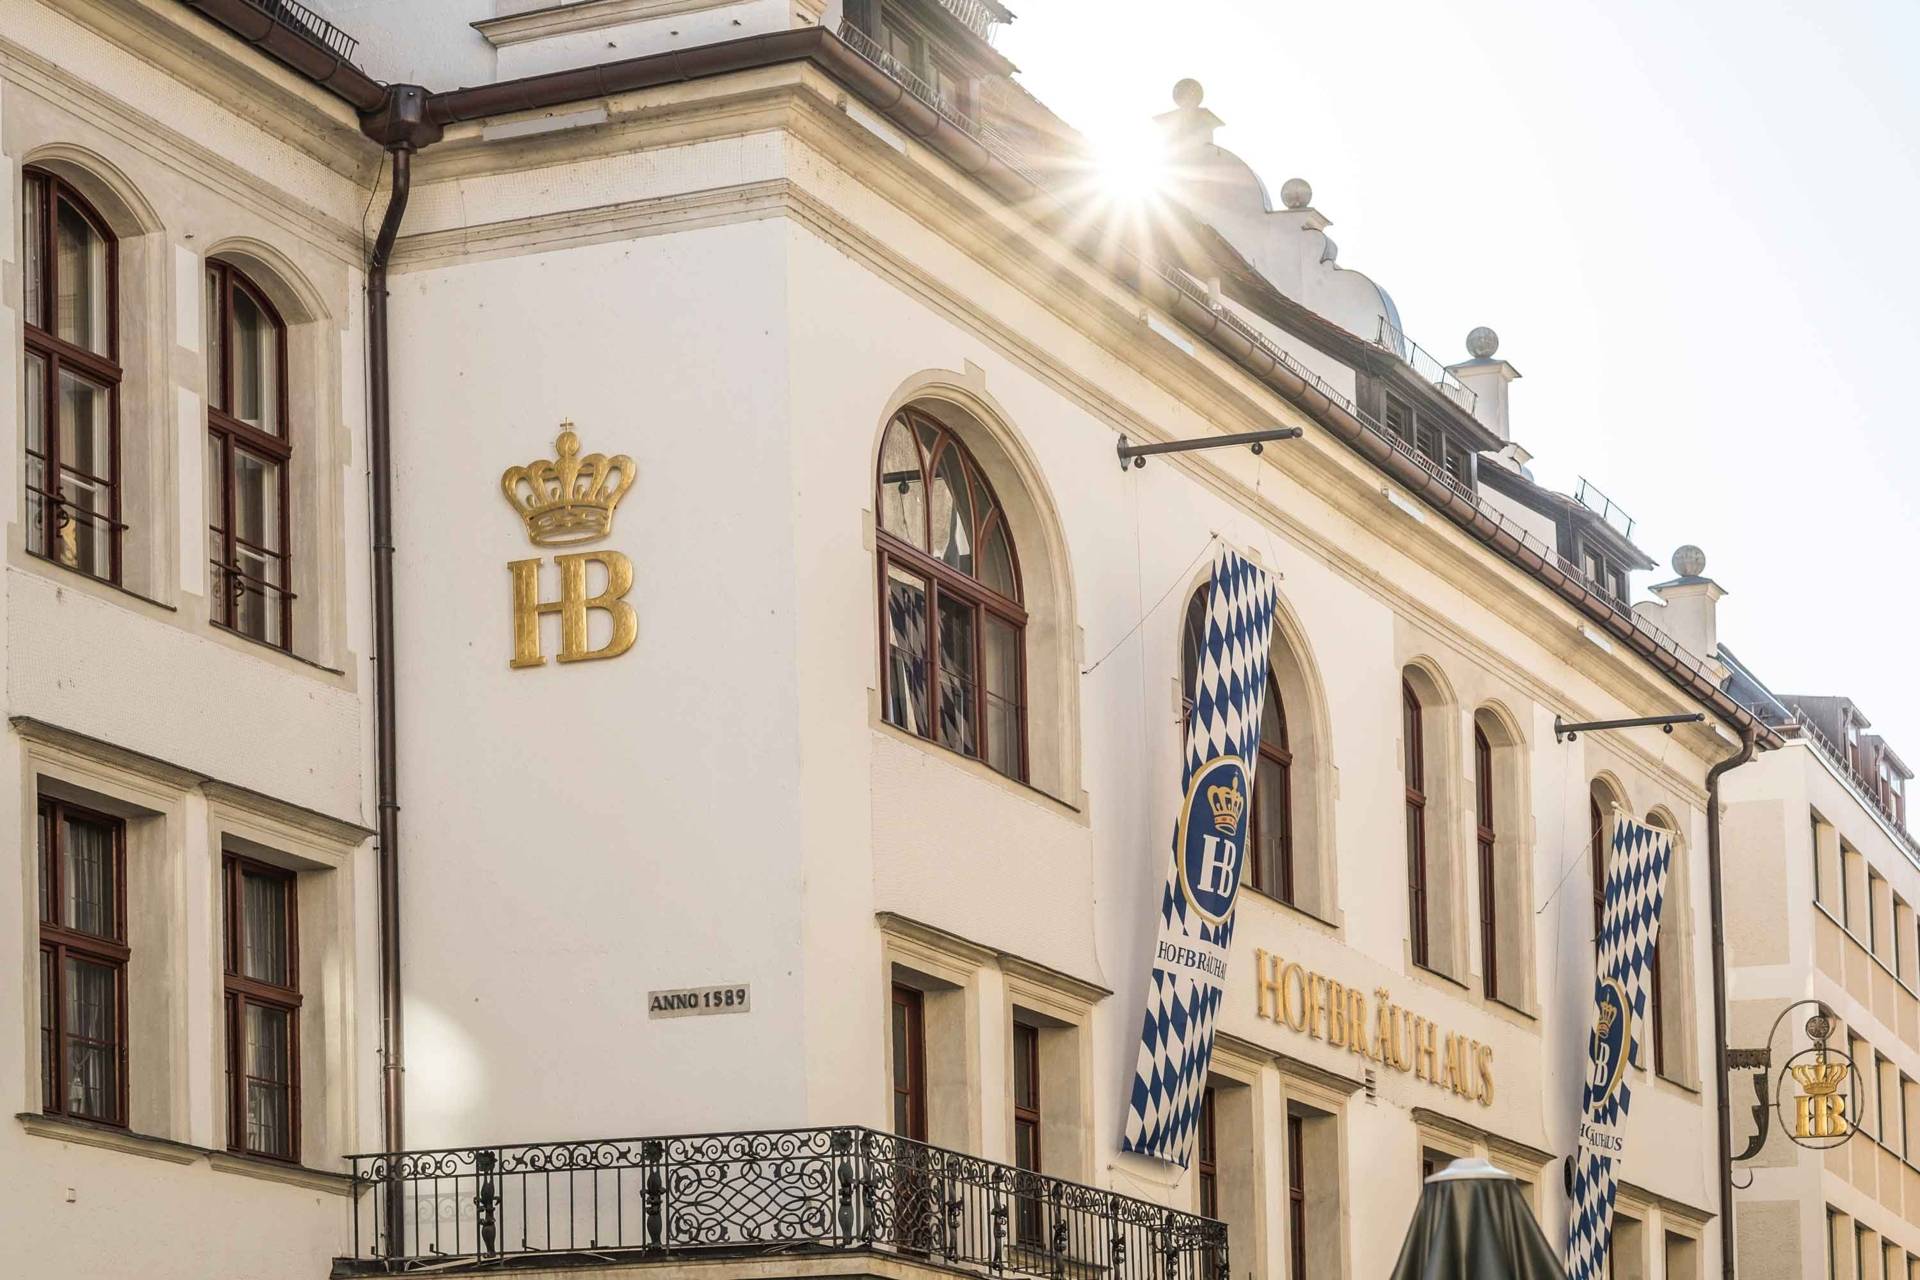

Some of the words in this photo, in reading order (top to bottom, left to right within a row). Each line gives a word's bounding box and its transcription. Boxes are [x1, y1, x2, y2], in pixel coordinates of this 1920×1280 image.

[507, 550, 638, 668] HB
[1197, 833, 1237, 898] HB
[650, 993, 699, 1012] ANNO
[703, 988, 746, 1008] 1589
[1256, 947, 1495, 1106] HOFBRÄUHAUS
[1793, 1094, 1848, 1137] HB
